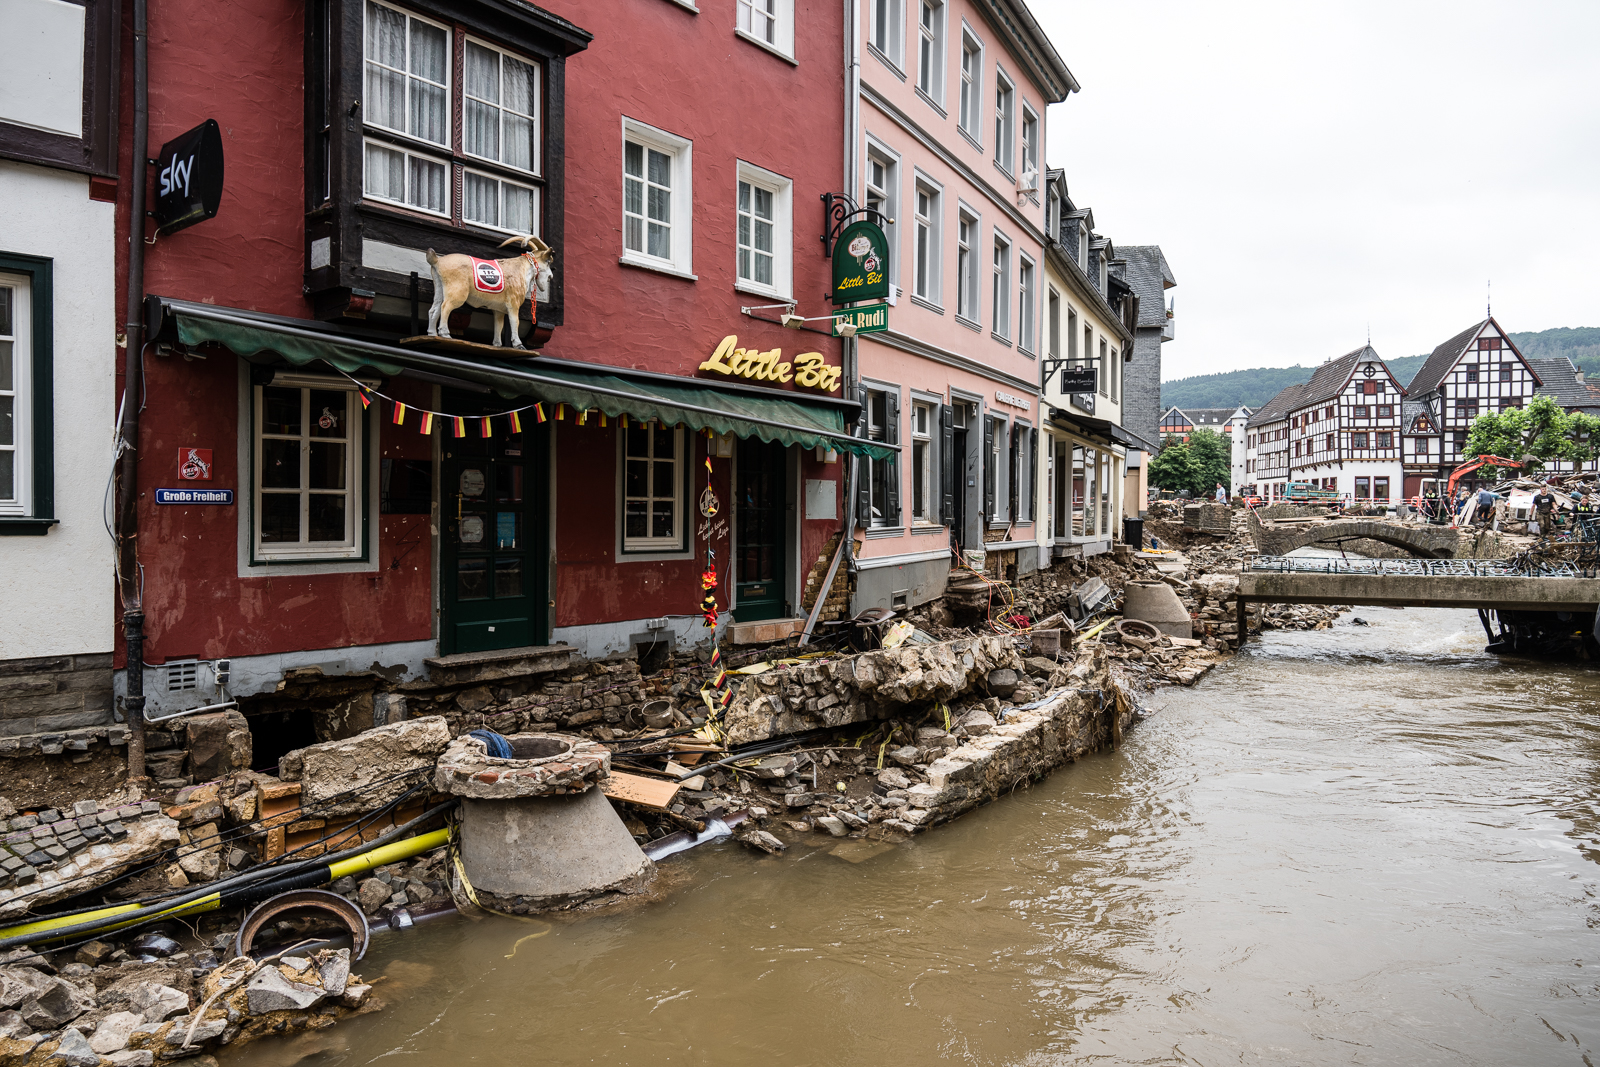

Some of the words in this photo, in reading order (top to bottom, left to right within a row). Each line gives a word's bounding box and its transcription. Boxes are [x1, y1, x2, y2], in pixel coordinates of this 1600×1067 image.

[160, 153, 195, 198] sky
[838, 275, 864, 290] Little
[867, 272, 883, 285] Bit
[857, 310, 885, 329] Rudi
[699, 335, 793, 383] Little
[793, 352, 842, 392] Bit
[163, 491, 191, 501] Große
[193, 491, 227, 502] Freiheit
